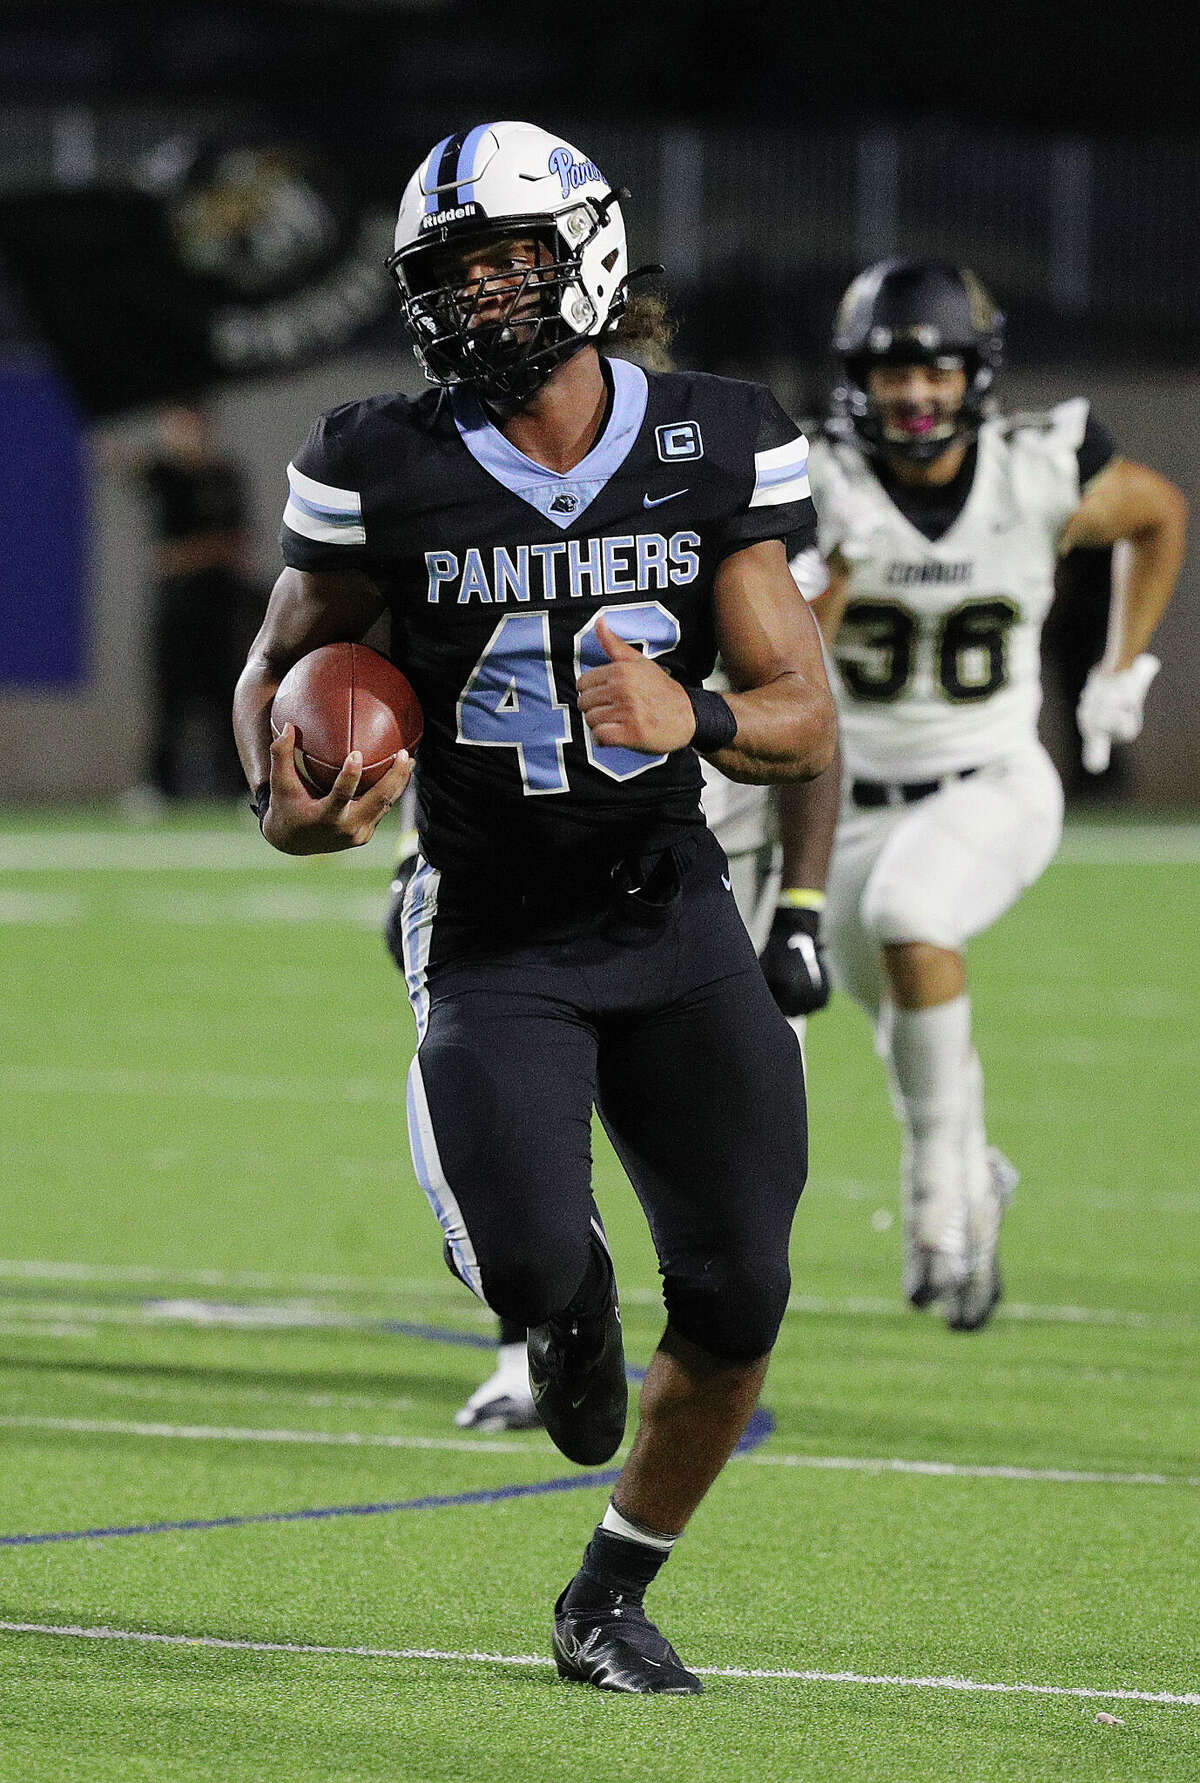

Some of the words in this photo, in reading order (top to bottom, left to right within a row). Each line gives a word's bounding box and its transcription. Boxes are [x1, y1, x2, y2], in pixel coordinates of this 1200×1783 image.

[423, 203, 476, 229] Riddell
[663, 426, 696, 456] C
[424, 531, 701, 604] PANTHERS
[833, 597, 1020, 705] 36
